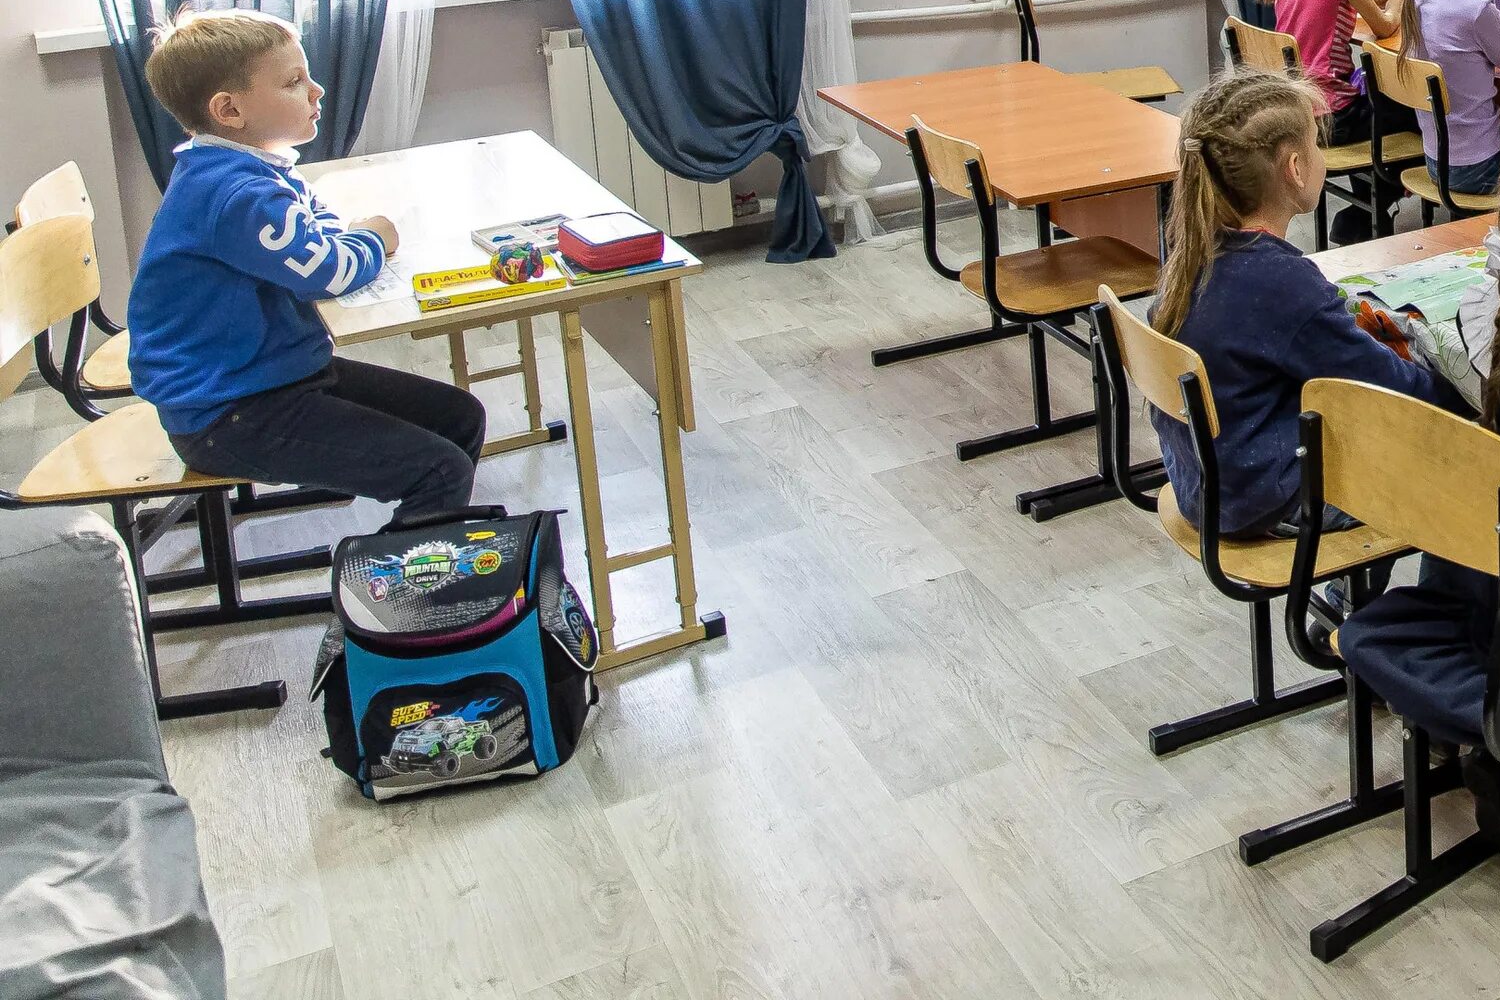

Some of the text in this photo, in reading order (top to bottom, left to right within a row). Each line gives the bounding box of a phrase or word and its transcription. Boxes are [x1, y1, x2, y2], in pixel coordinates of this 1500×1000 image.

[416, 574, 439, 583] DRIVE
[392, 701, 430, 718] SUPER
[390, 712, 427, 728] SPEED
